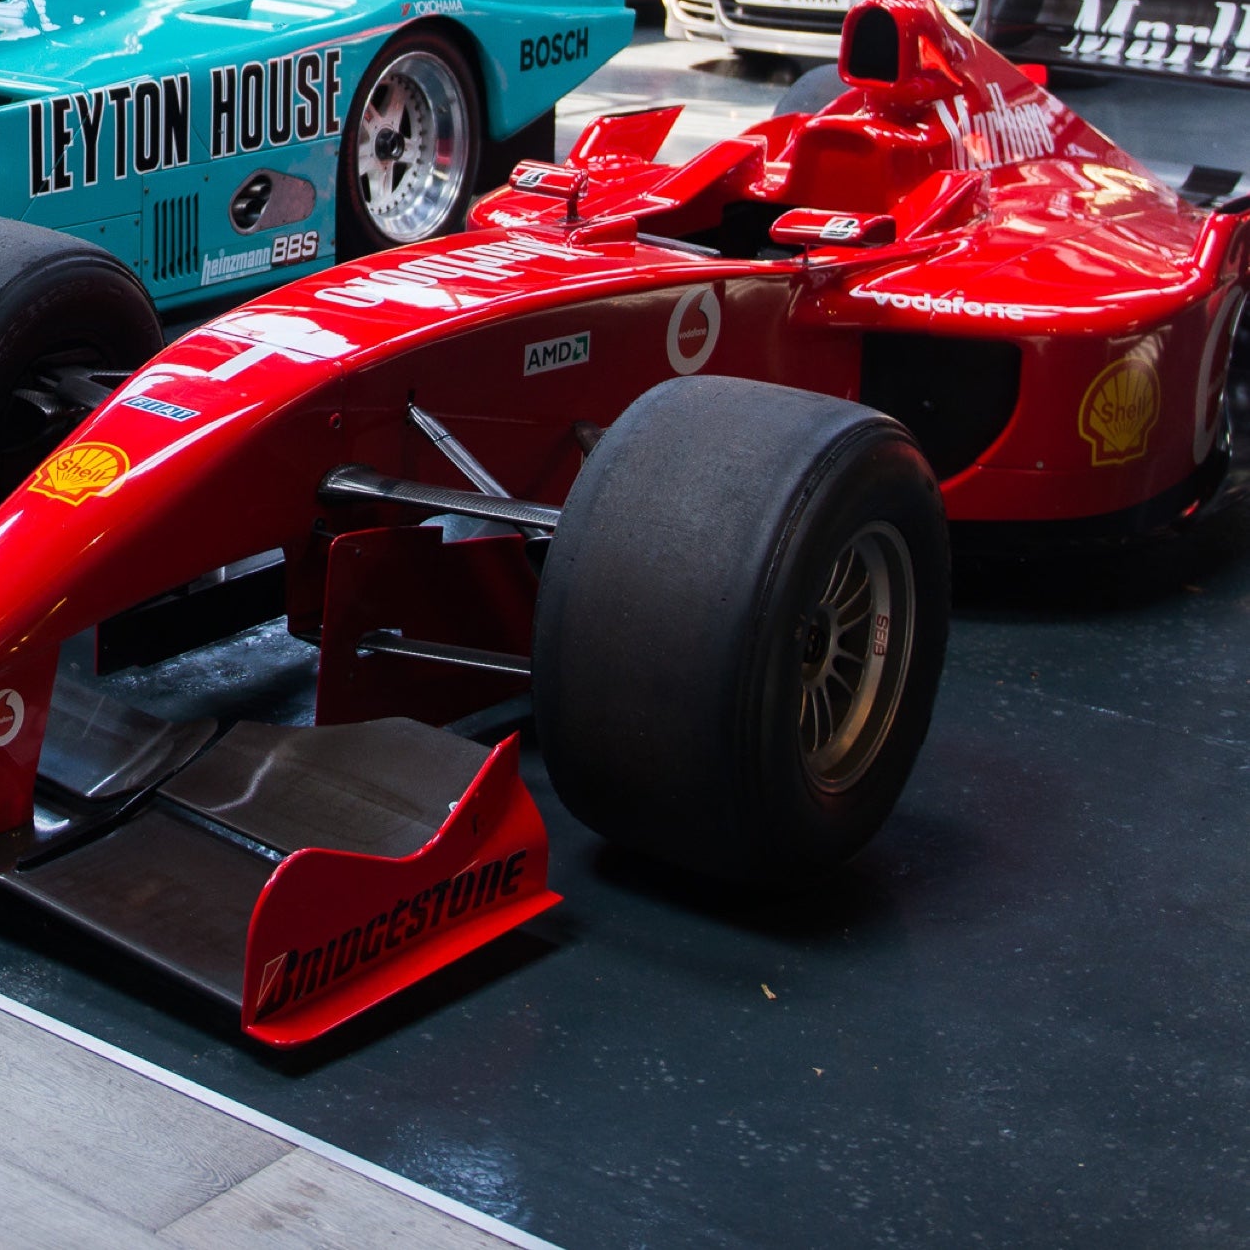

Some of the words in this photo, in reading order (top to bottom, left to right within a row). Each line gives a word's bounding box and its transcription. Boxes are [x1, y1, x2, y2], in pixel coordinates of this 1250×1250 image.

[520, 27, 589, 72] BOSCH
[28, 72, 190, 198] LEYTON
[209, 47, 342, 160] HOUSE
[201, 248, 271, 286] heinzmann
[271, 230, 319, 264] BBS
[870, 289, 1025, 321] vodafone
[526, 341, 572, 371] AMD
[1100, 397, 1145, 424] Shell
[57, 458, 106, 482] Shell
[873, 613, 889, 656] BBS
[253, 848, 527, 1023] BRIDGESTONE
